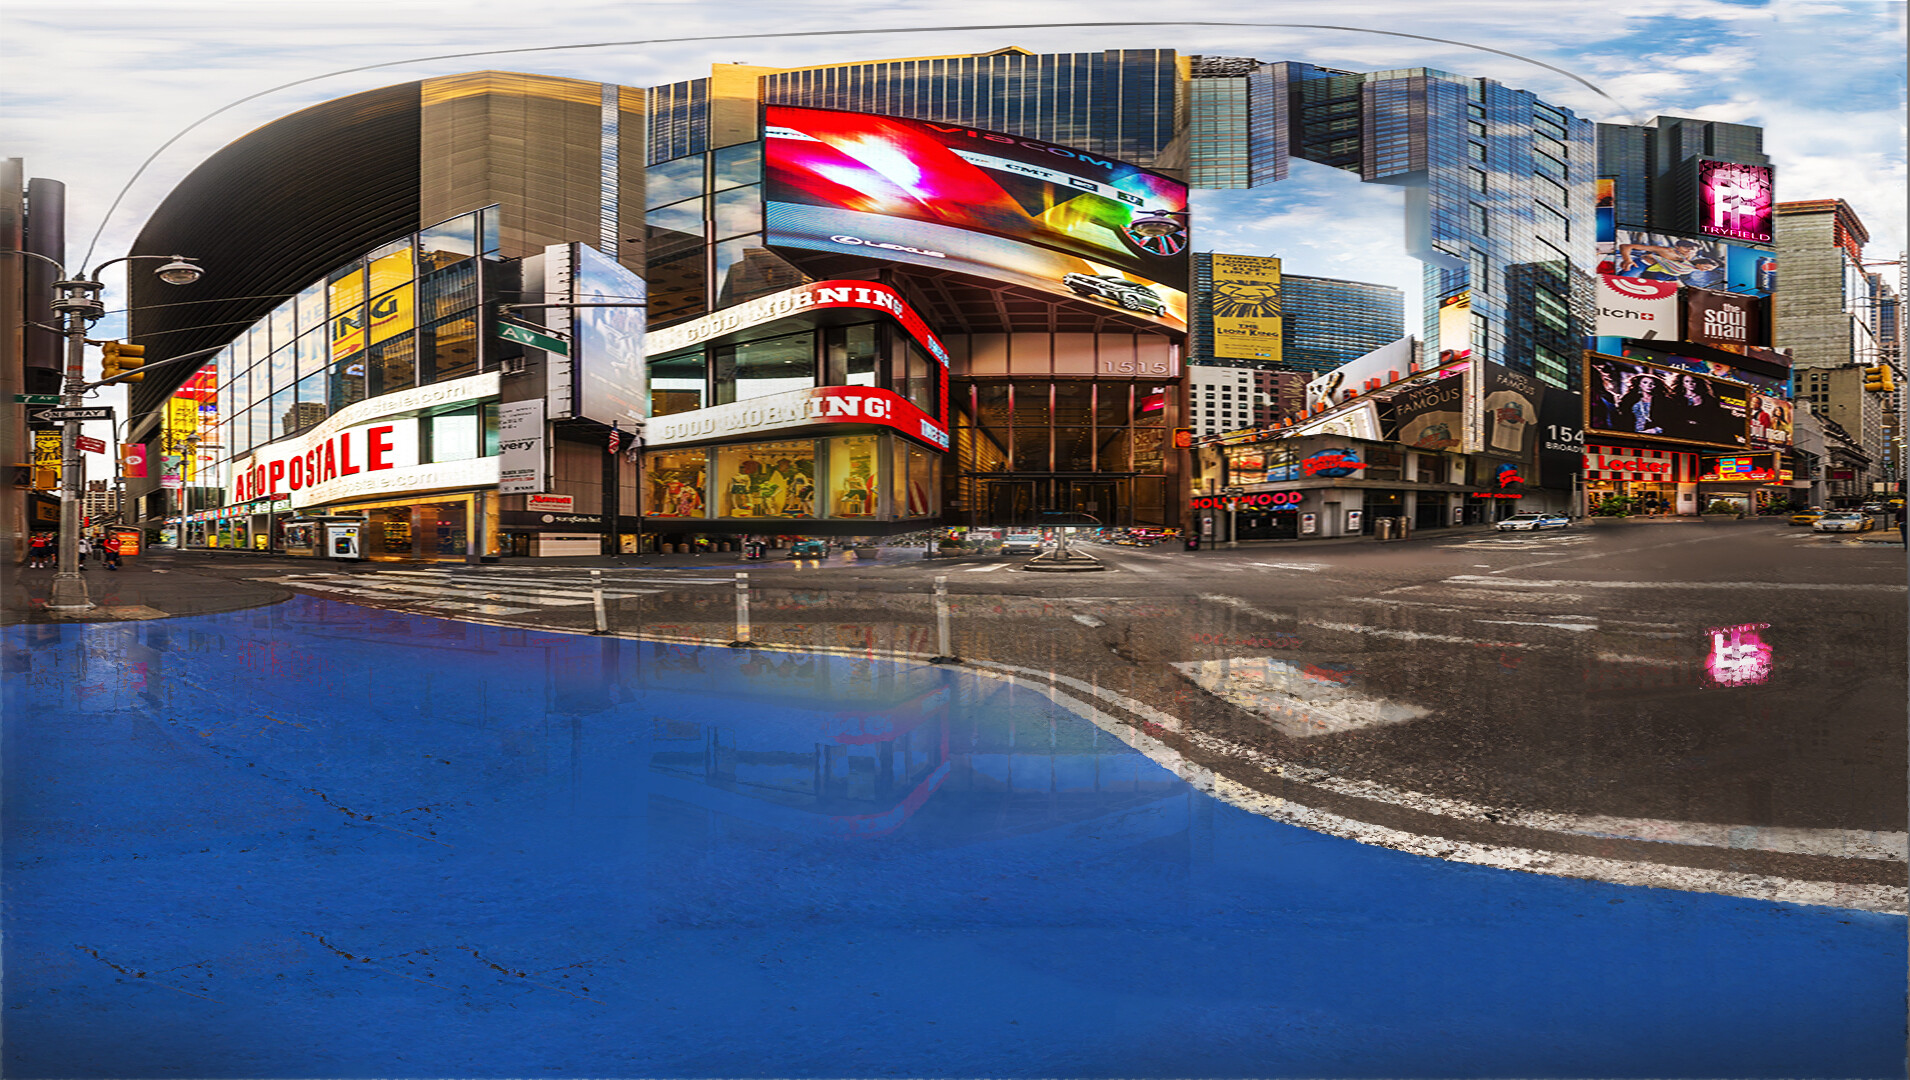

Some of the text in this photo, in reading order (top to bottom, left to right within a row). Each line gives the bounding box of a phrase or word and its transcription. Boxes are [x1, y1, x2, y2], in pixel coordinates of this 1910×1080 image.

[1701, 225, 1771, 241] TRYFIELD
[864, 240, 946, 258] LEXUS
[1722, 303, 1741, 312] the
[1704, 308, 1747, 326] soul
[1704, 322, 1747, 339] man
[1105, 361, 1168, 374] 1515
[1397, 388, 1461, 415] FAMOUS
[1597, 455, 1671, 473] Locker
